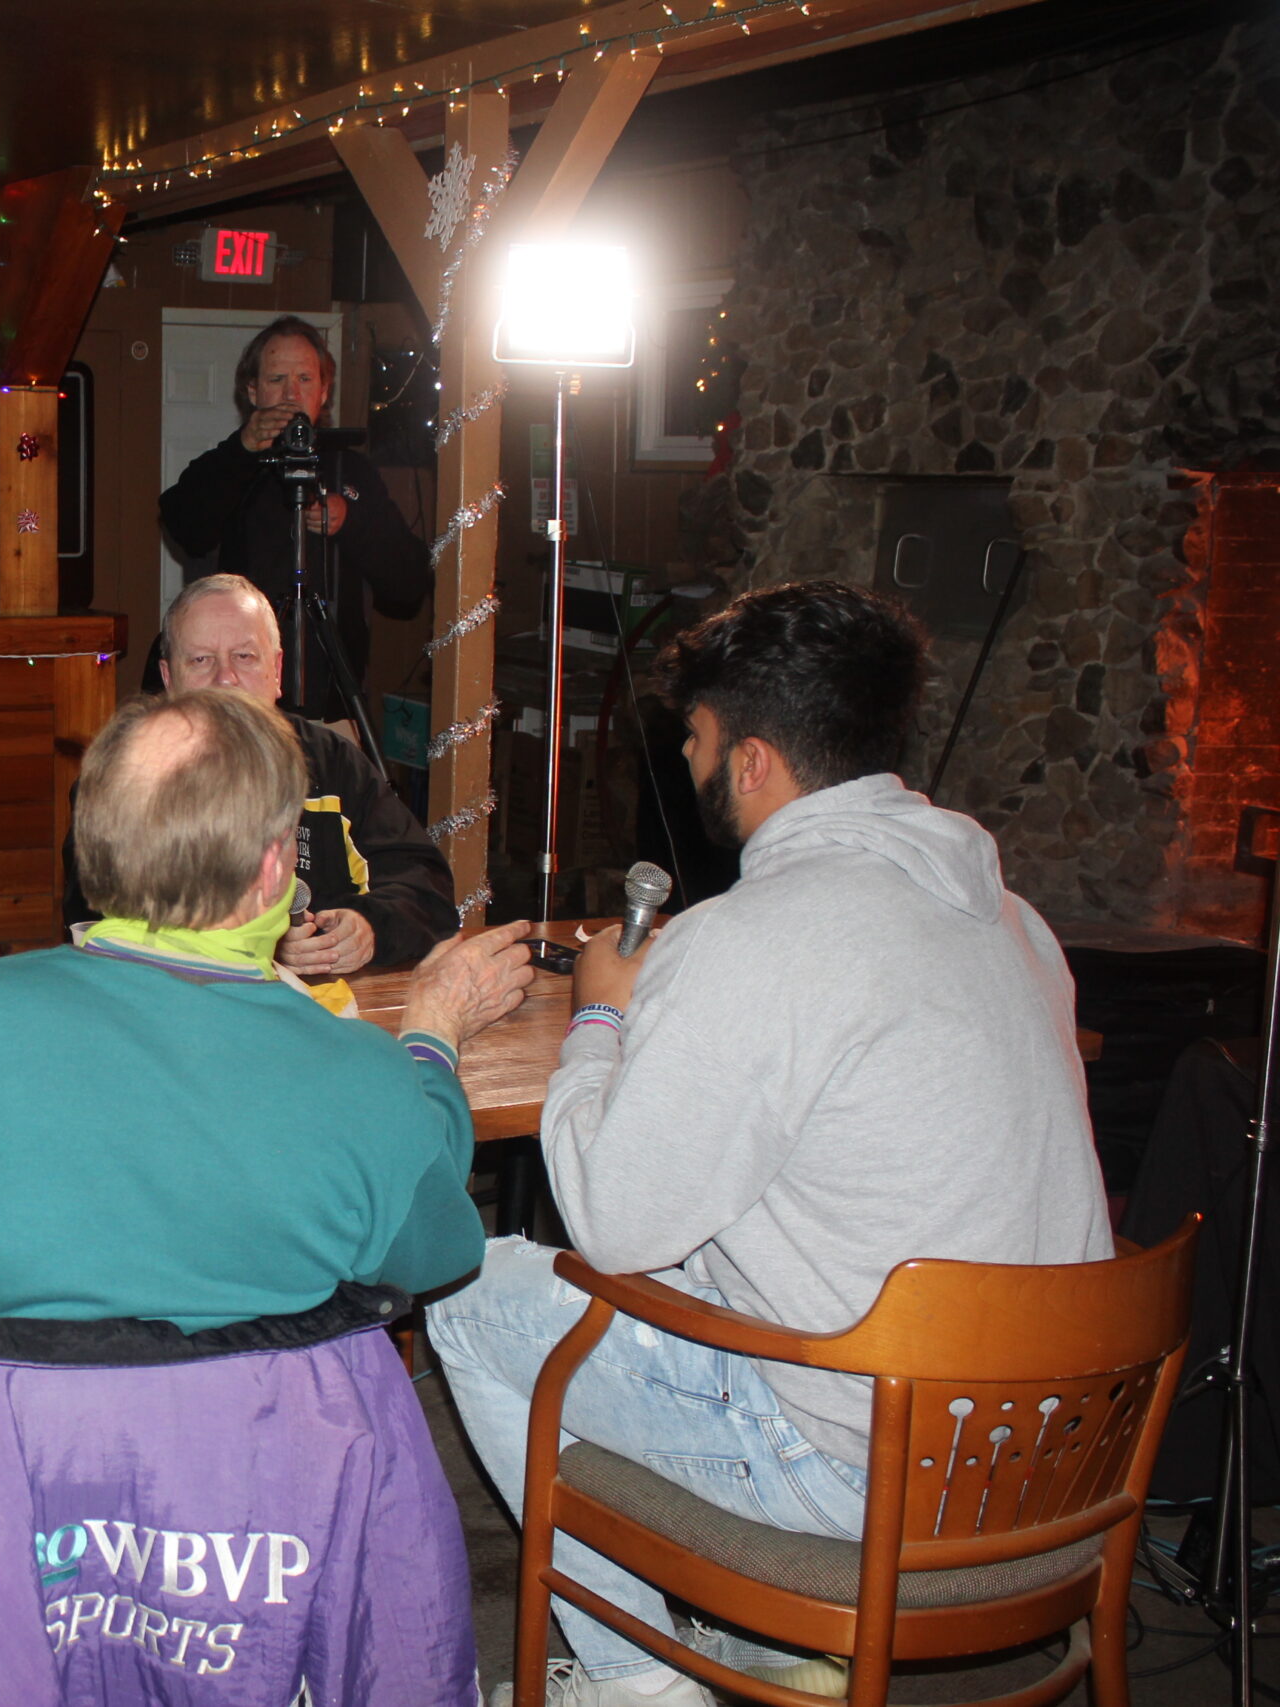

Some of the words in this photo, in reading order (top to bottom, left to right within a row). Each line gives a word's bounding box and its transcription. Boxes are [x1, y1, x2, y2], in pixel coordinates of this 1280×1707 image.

[214, 230, 269, 276] EXIT
[83, 1519, 310, 1604] WBVP
[46, 1592, 244, 1676] SPORTS
